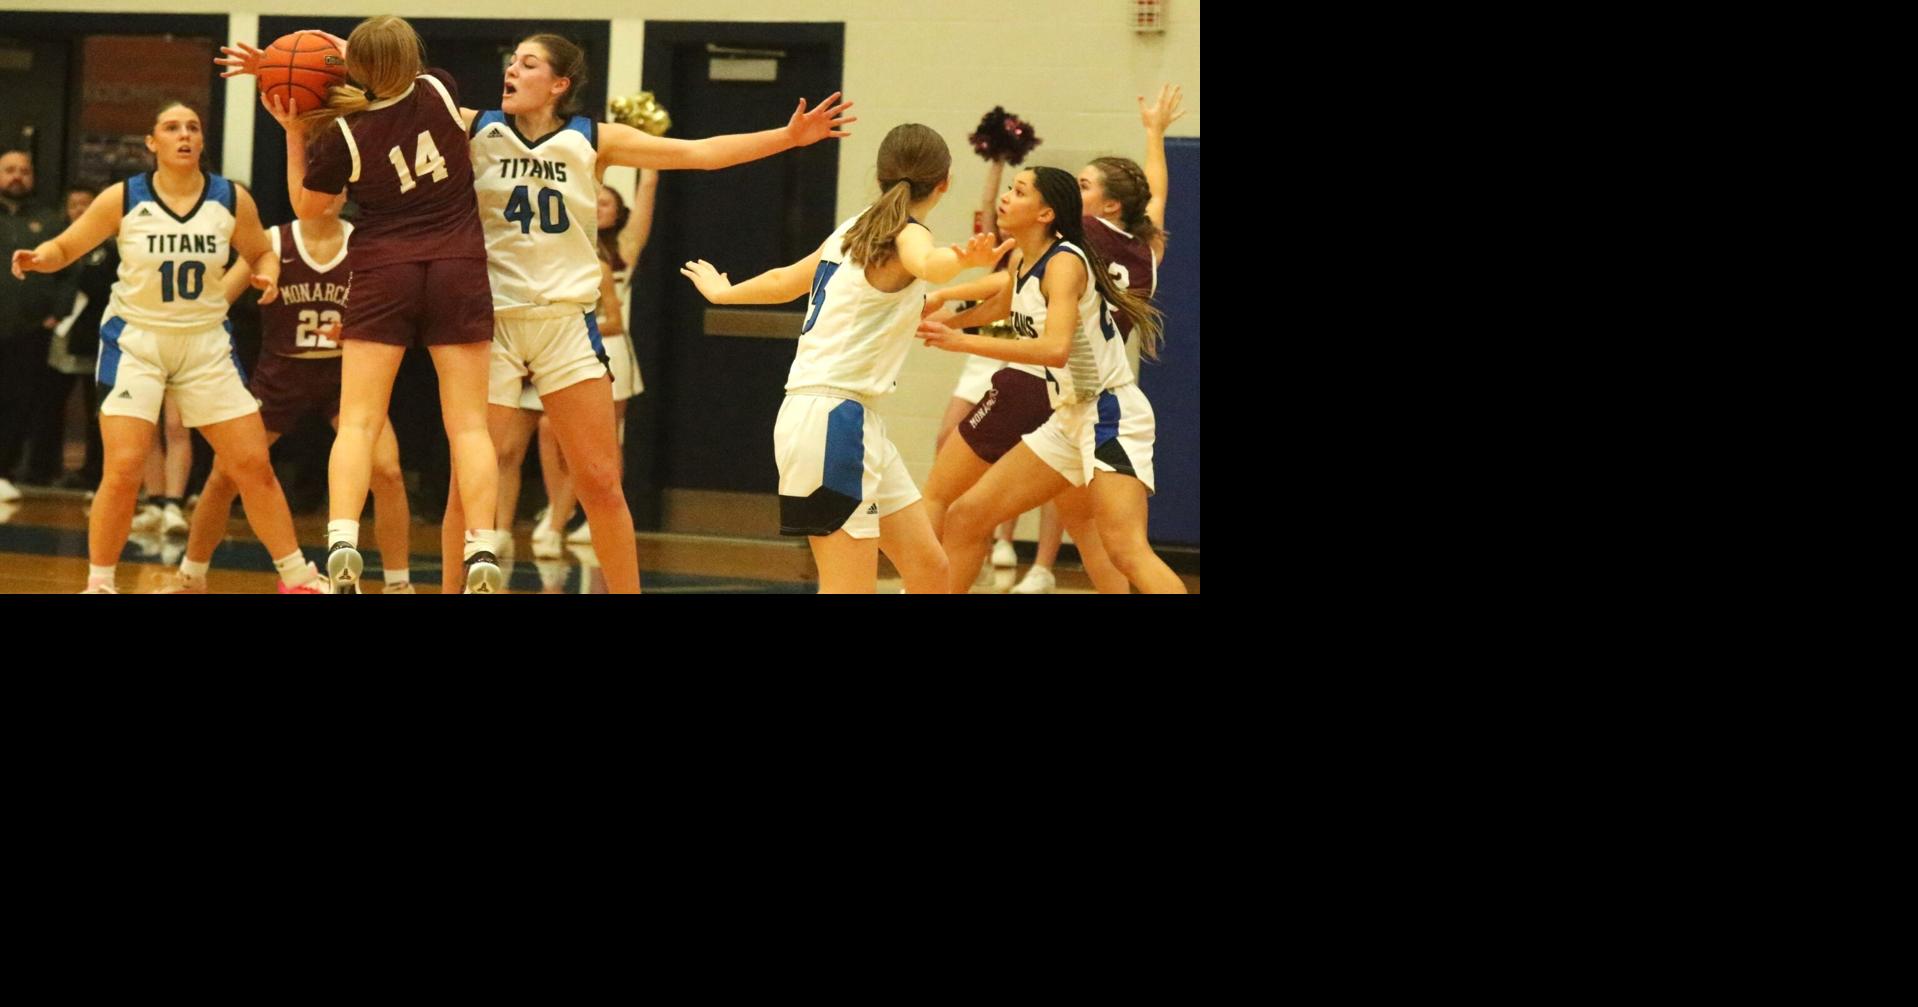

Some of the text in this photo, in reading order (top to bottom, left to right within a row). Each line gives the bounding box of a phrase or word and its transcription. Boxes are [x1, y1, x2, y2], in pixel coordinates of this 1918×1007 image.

[389, 130, 448, 194] 14
[499, 158, 567, 182] TITANS
[503, 185, 570, 234] 40
[147, 234, 216, 253] TITANS
[158, 260, 206, 302] 10
[296, 310, 341, 348] 22
